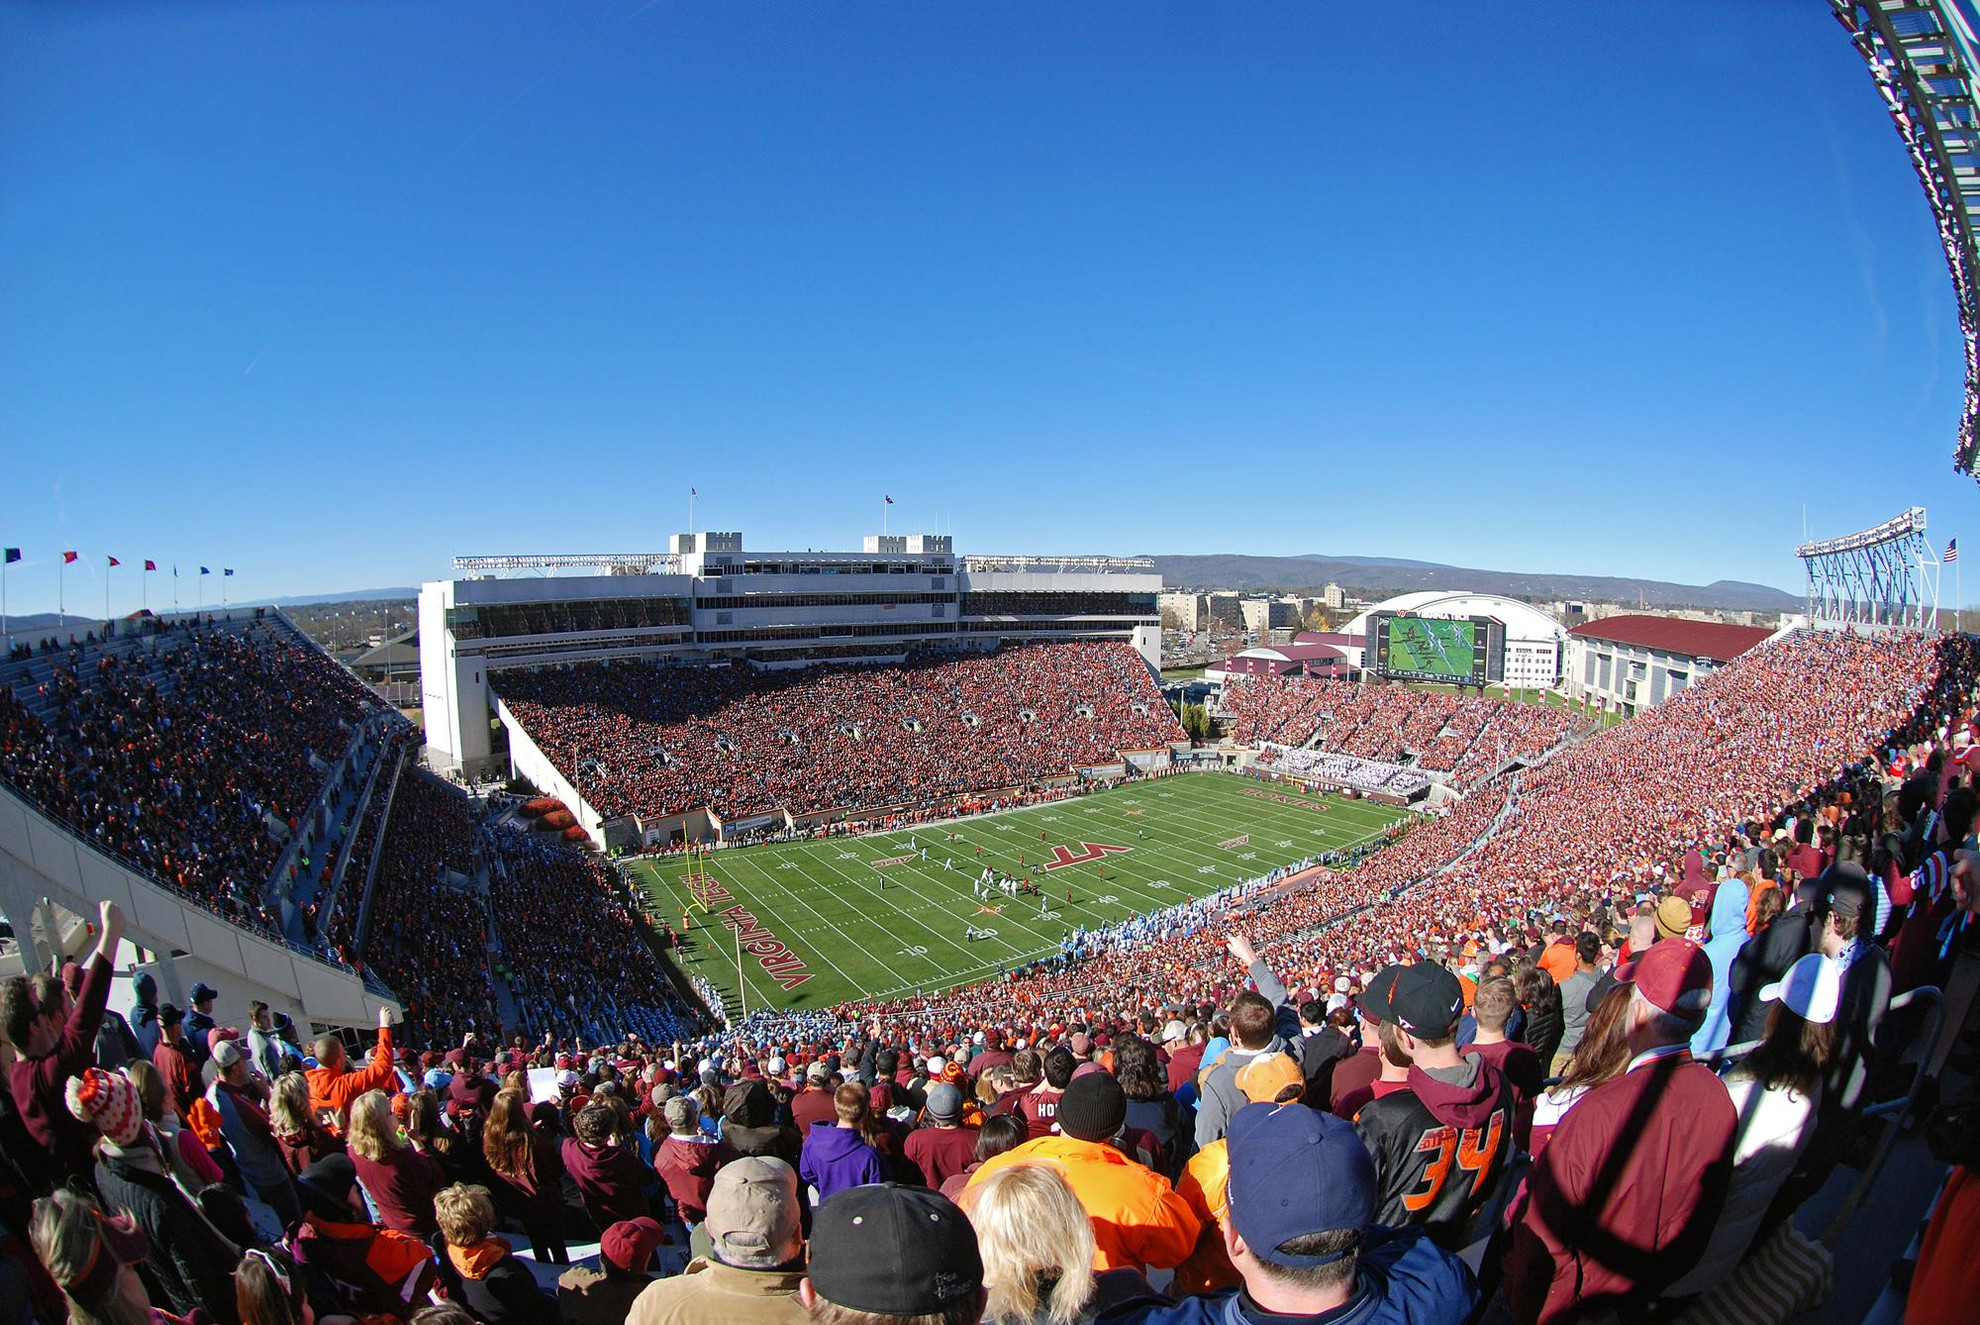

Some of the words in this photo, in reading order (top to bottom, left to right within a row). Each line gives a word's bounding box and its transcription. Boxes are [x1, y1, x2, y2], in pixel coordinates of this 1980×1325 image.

[679, 871, 735, 906] TECH
[714, 904, 816, 991] VIRGINIA
[903, 945, 928, 956] 10
[1038, 1103, 1058, 1117] HO
[1401, 1109, 1505, 1211] 34
